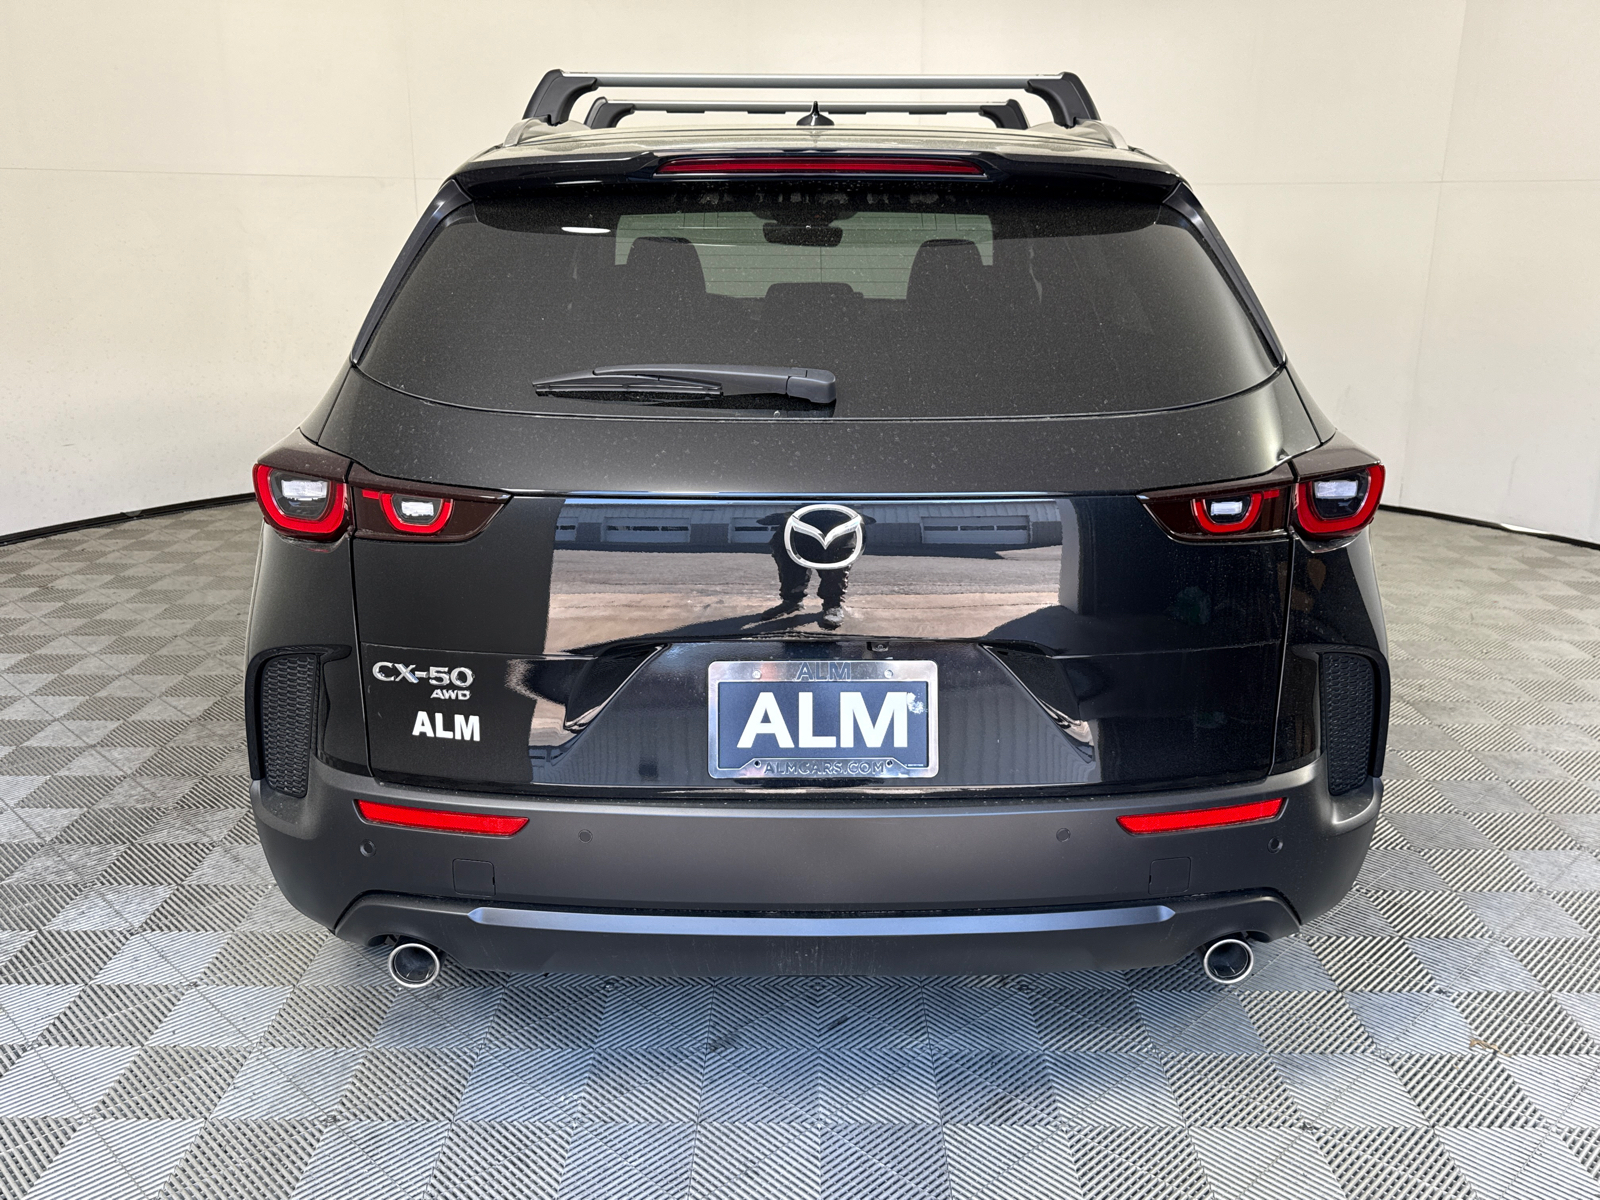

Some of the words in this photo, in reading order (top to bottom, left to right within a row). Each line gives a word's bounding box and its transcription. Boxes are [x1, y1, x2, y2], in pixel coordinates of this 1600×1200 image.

[372, 661, 474, 688] CX-50
[796, 661, 851, 681] ALM
[430, 689, 471, 700] AWD
[411, 711, 481, 741] ALM
[736, 691, 908, 748] ALM
[763, 761, 885, 776] ALMCARS.COM
